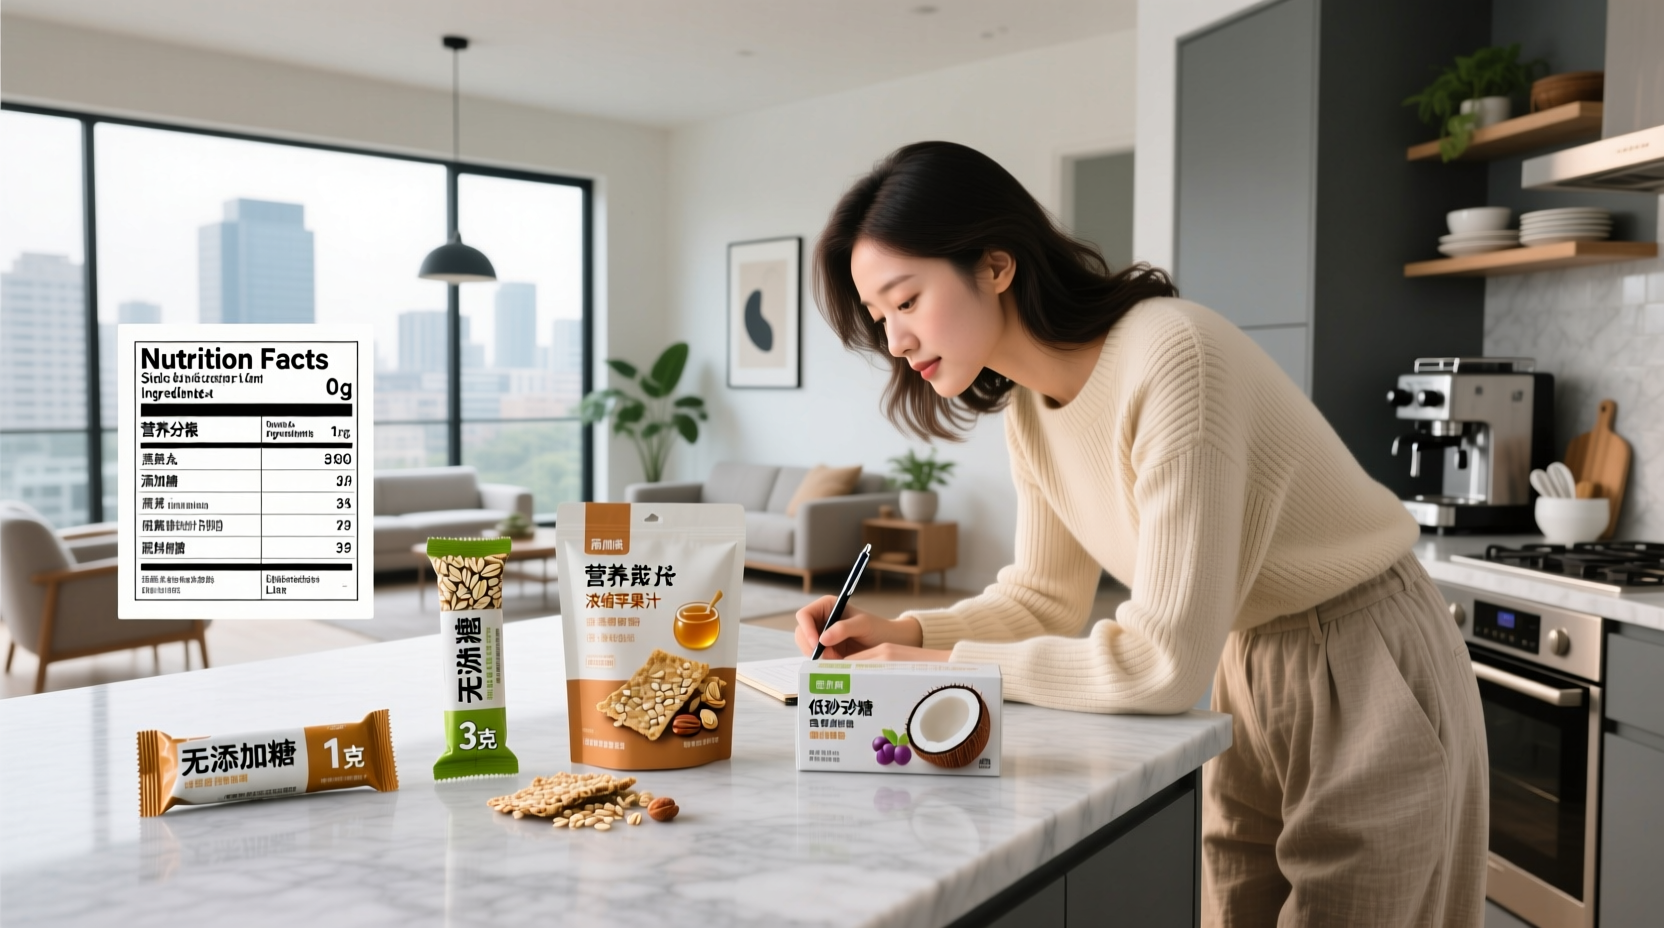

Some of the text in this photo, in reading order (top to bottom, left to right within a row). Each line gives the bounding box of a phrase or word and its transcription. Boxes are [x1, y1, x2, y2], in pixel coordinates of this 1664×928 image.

[459, 721, 498, 750] 3克
[181, 738, 298, 777] 无添加糖
[323, 737, 366, 770] 1克
